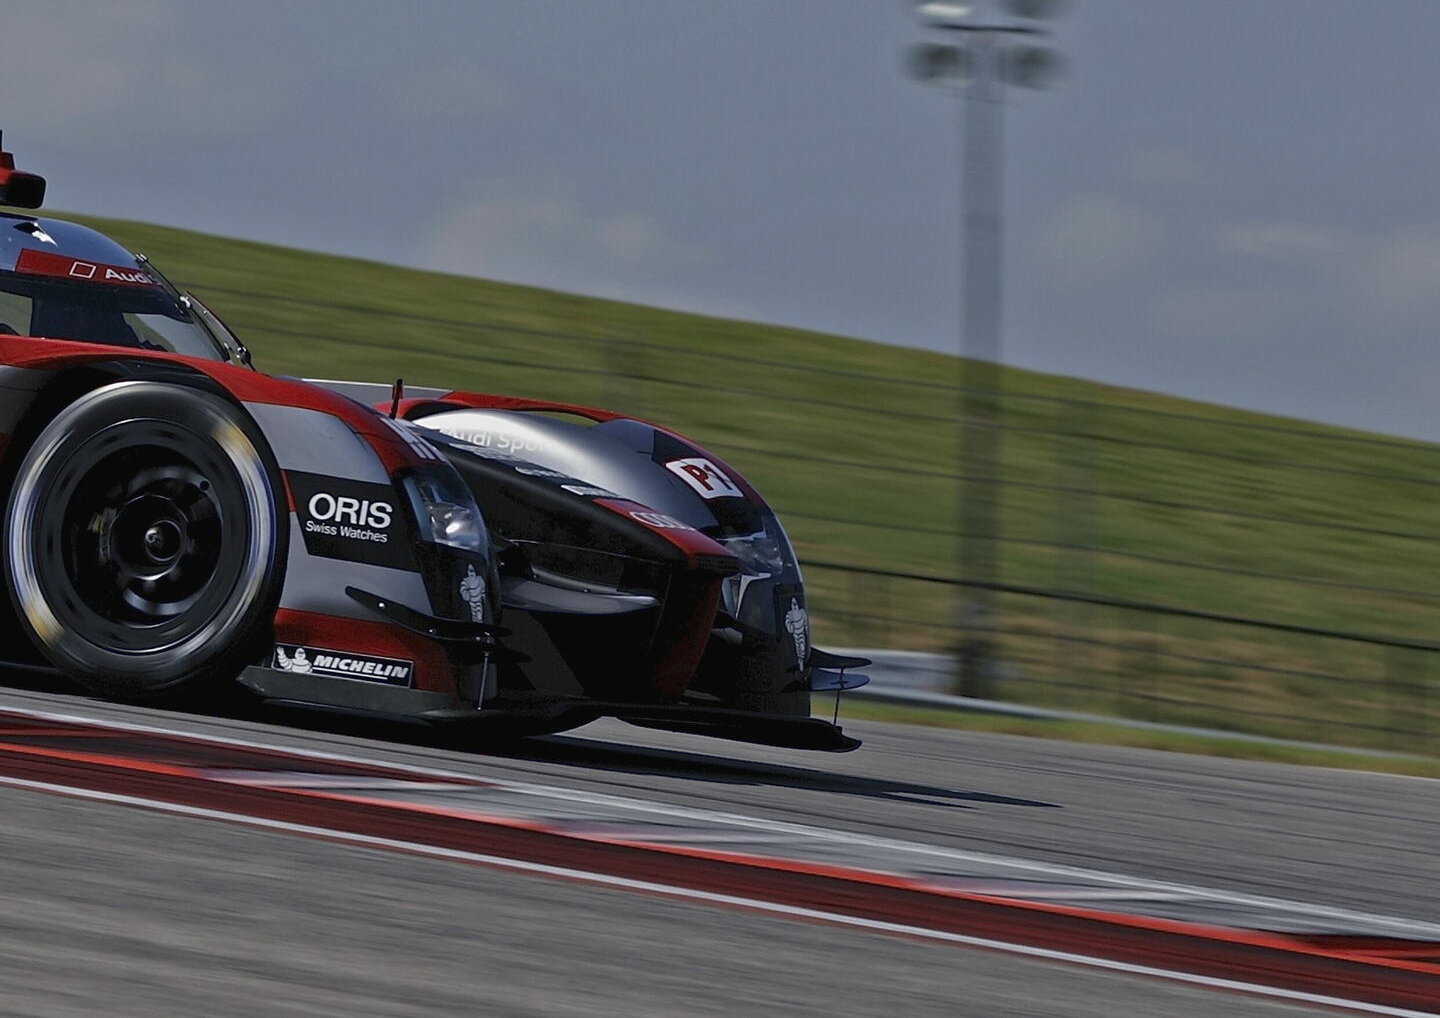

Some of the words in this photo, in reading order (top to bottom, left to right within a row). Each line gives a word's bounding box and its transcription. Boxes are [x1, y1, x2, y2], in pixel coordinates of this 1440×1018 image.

[680, 464, 733, 492] P1
[308, 492, 393, 529] ORIS
[305, 520, 337, 536] Swiss
[340, 525, 388, 543] Watches
[313, 655, 409, 679] MICHELIN
